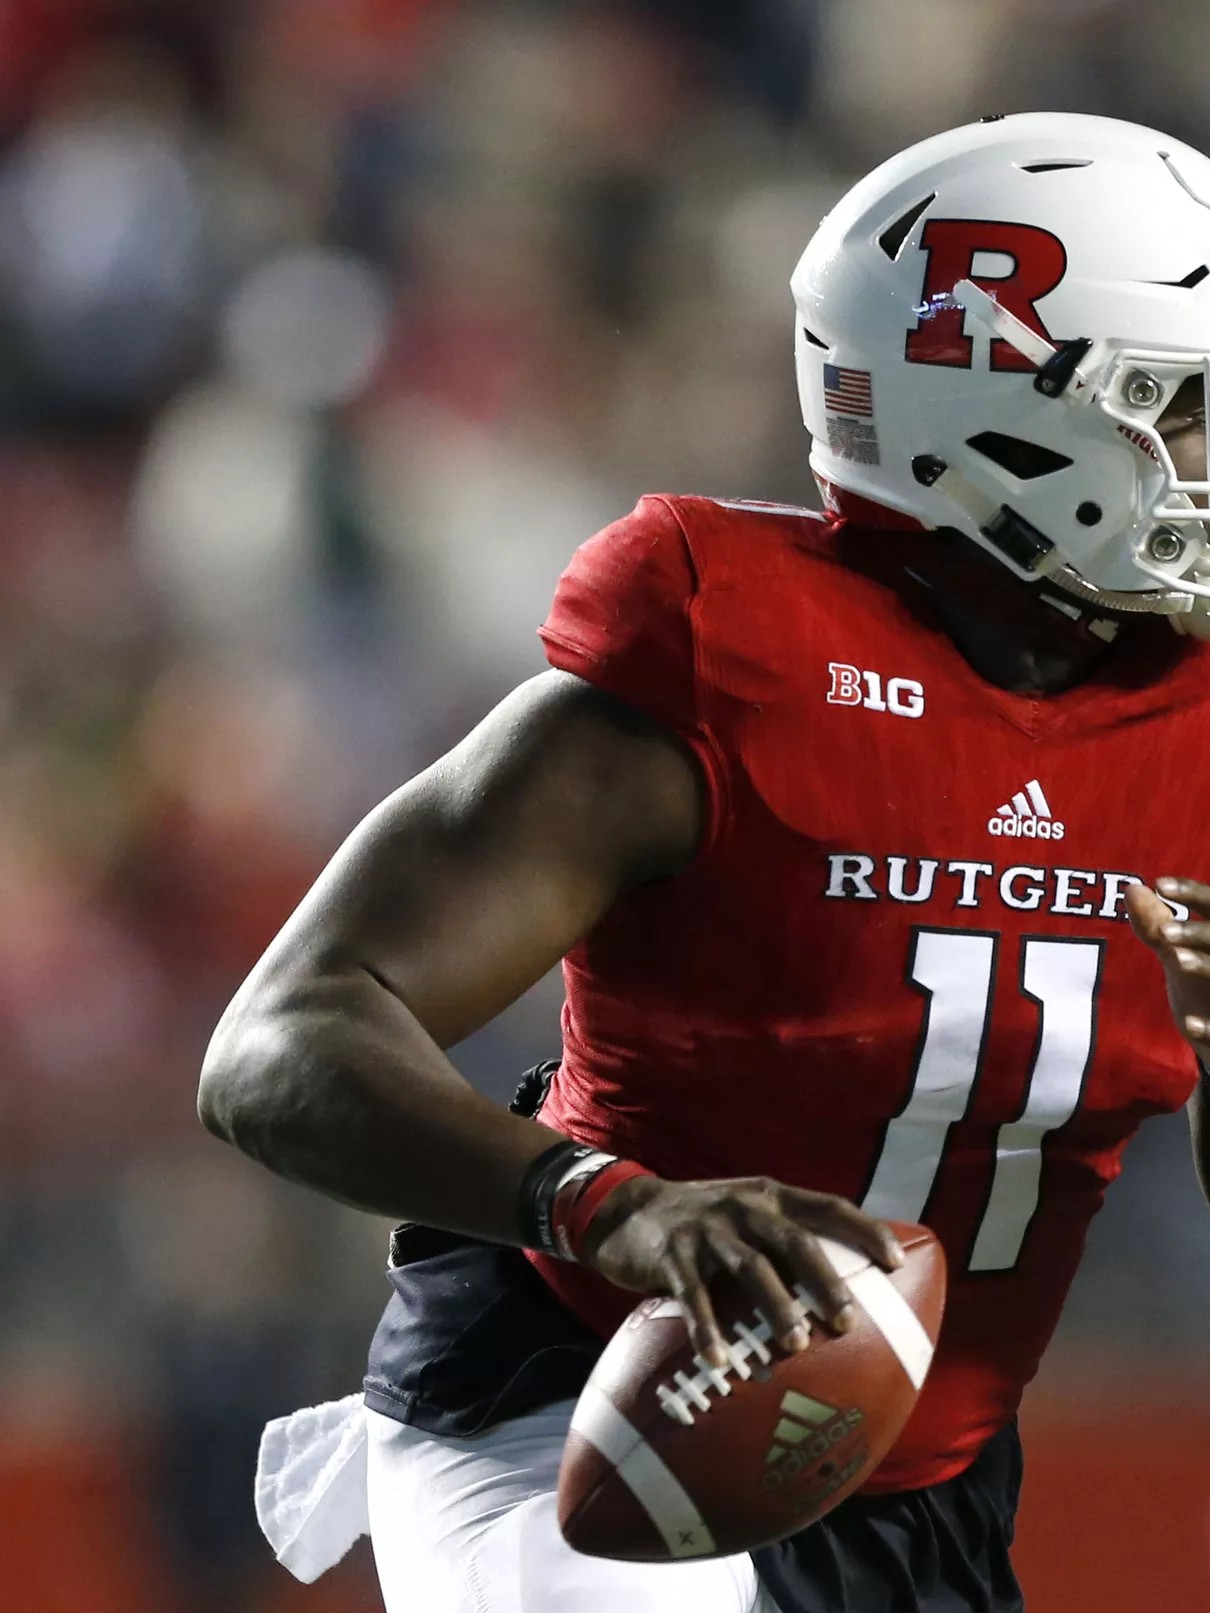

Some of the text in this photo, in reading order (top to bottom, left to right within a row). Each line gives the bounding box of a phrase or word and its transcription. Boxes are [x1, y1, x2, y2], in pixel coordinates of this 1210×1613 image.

[904, 217, 1072, 374] R
[987, 814, 1066, 840] adidas
[858, 926, 1106, 1274] 11
